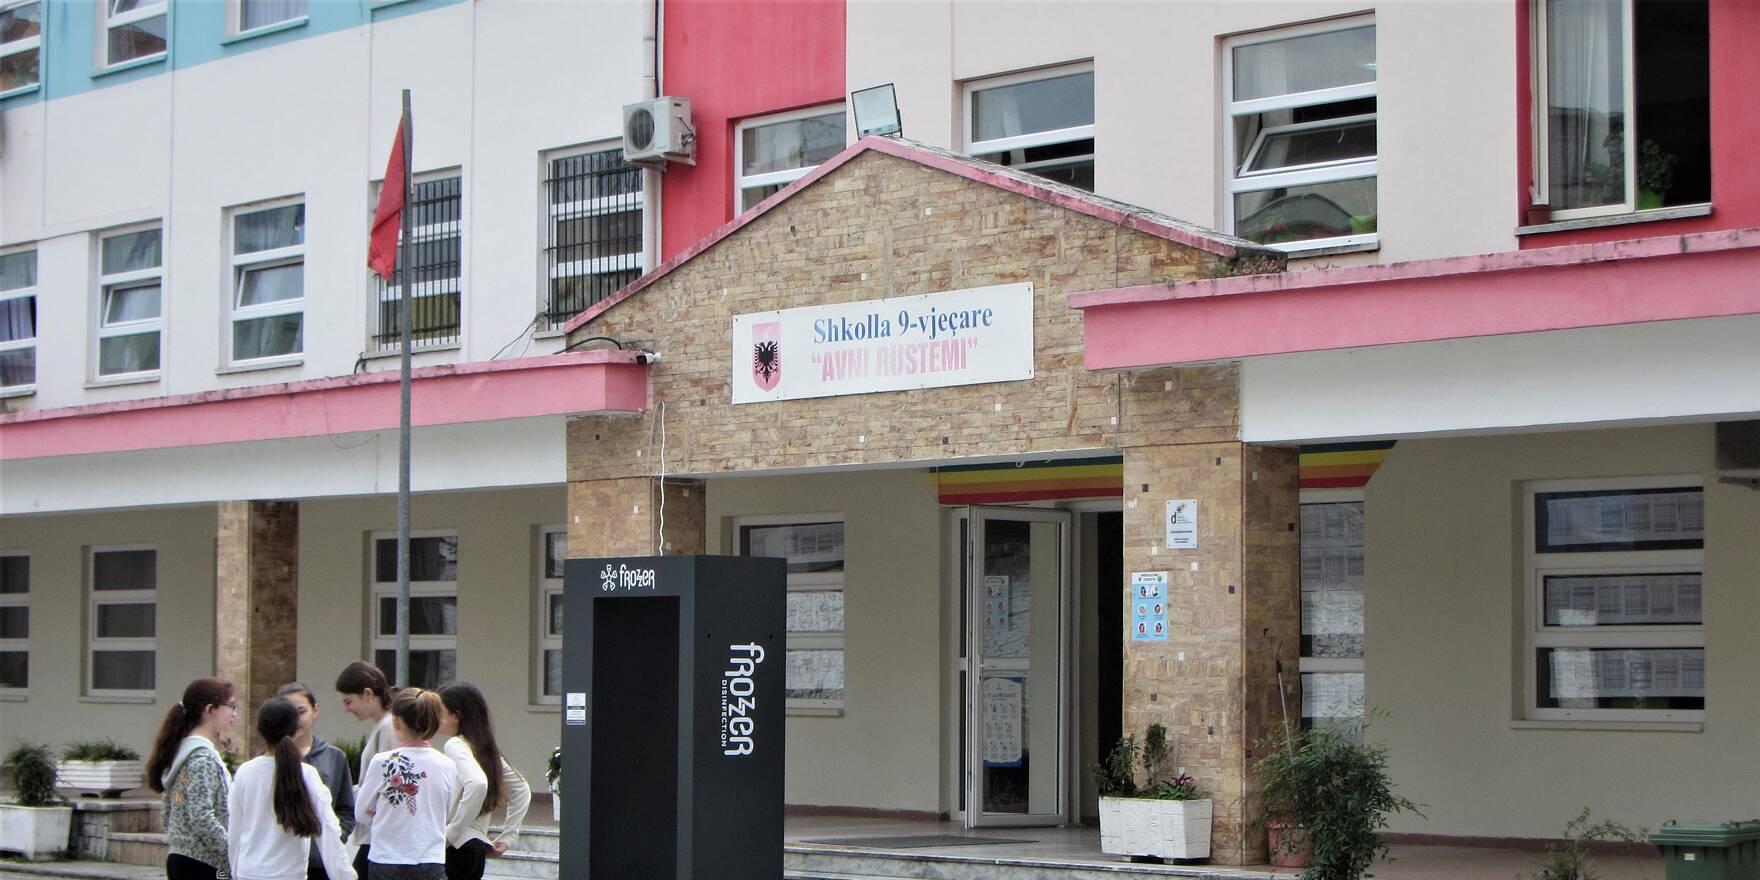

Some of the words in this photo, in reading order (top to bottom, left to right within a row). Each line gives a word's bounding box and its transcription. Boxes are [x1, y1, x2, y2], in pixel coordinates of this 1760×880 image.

[814, 314, 891, 344] Shkolla
[898, 307, 992, 340] 9-vjeçare
[720, 679, 728, 747] DISINFECTION
